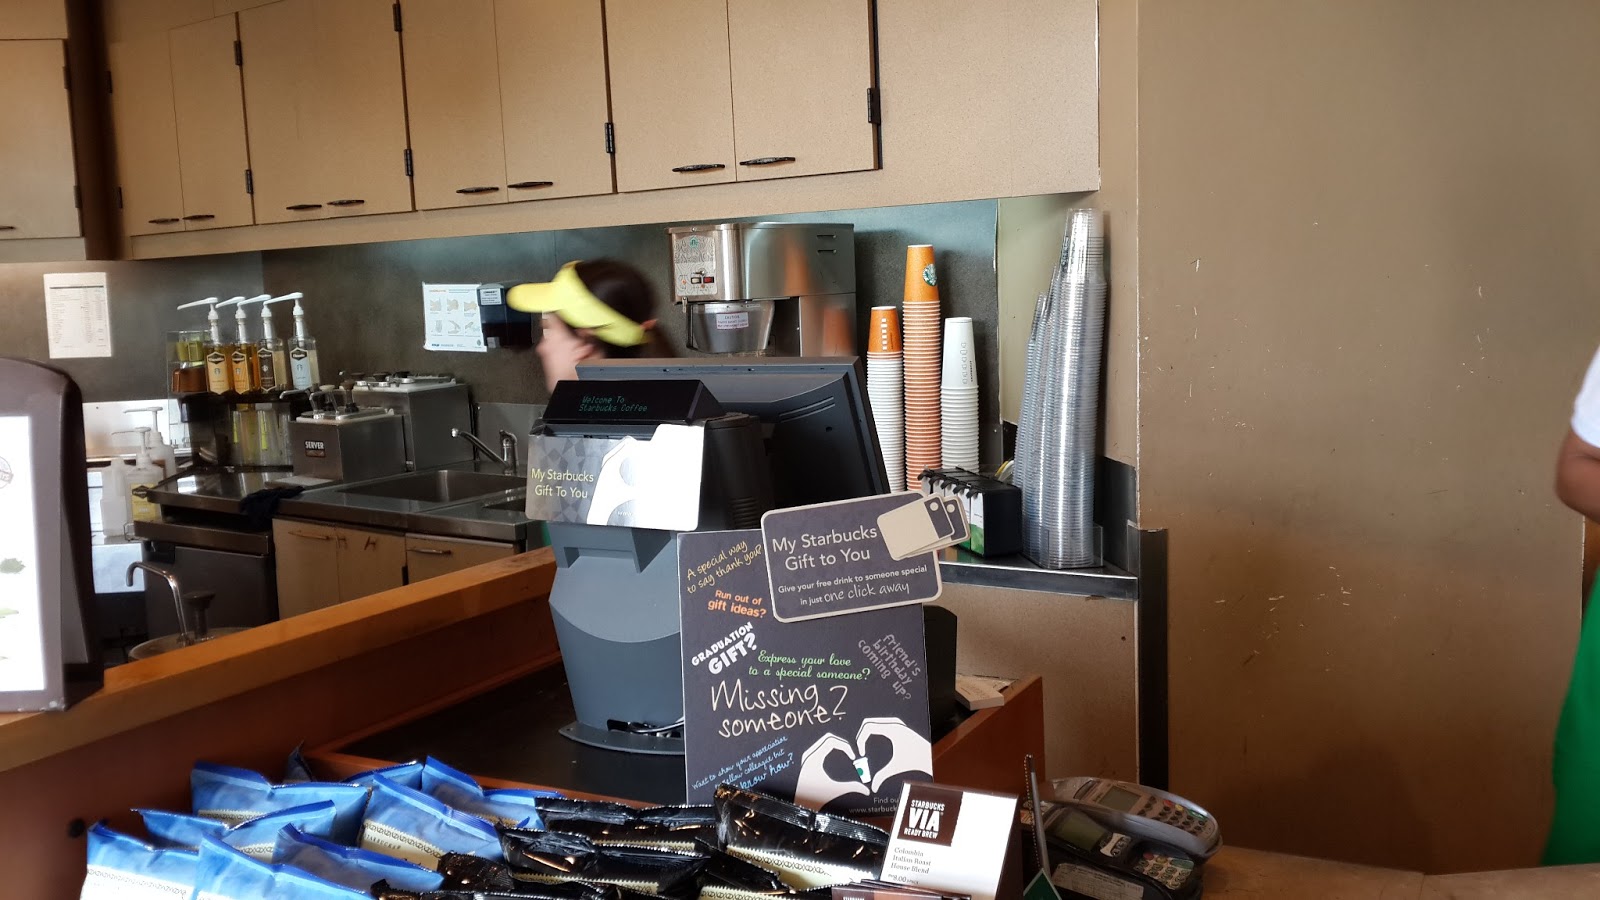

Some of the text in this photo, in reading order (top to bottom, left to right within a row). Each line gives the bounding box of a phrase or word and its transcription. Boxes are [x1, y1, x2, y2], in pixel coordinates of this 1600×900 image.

[578, 404, 648, 412] Starbucks Coffee
[582, 396, 612, 404] Welcome
[305, 440, 324, 450] SERVER
[531, 468, 594, 483] My Starbucks
[535, 485, 588, 499] Gift To You
[772, 525, 877, 554] My Starbucks
[687, 541, 748, 580] A special way
[785, 548, 870, 571] Gift to You
[687, 584, 697, 593] to
[698, 574, 715, 587] say
[716, 557, 743, 577] thank
[778, 585, 796, 594] Give
[797, 582, 814, 593] your
[816, 579, 832, 588] free
[834, 576, 853, 586] drink
[865, 570, 900, 581] someone
[901, 564, 928, 577] special
[715, 590, 762, 606] Run out of
[808, 597, 822, 606] just
[824, 590, 844, 603] one
[848, 583, 876, 599] click
[879, 582, 910, 594] away
[708, 600, 767, 618] gift ideas?
[691, 621, 753, 666] GRADUATION
[708, 632, 757, 675] GIFT?
[758, 650, 852, 668] Express your love
[873, 638, 912, 685] birthday
[748, 666, 758, 676] to
[776, 666, 812, 680] special
[816, 668, 871, 680] someone?
[858, 640, 911, 700] coming up?
[711, 678, 819, 714] Missing
[692, 778, 709, 790] Want
[718, 764, 735, 777] show
[736, 755, 752, 770] your
[752, 736, 789, 758] appreciation
[740, 752, 795, 789] know how?
[744, 755, 773, 775] colleague
[773, 748, 785, 759] but
[849, 804, 898, 813] www.starbuck
[911, 799, 945, 812] STARBUCKS
[908, 807, 941, 832] VIA
[904, 827, 939, 839] READY BREW
[893, 854, 931, 866] Italian Roast
[894, 846, 924, 857] Colombia
[891, 862, 930, 874] House Blend
